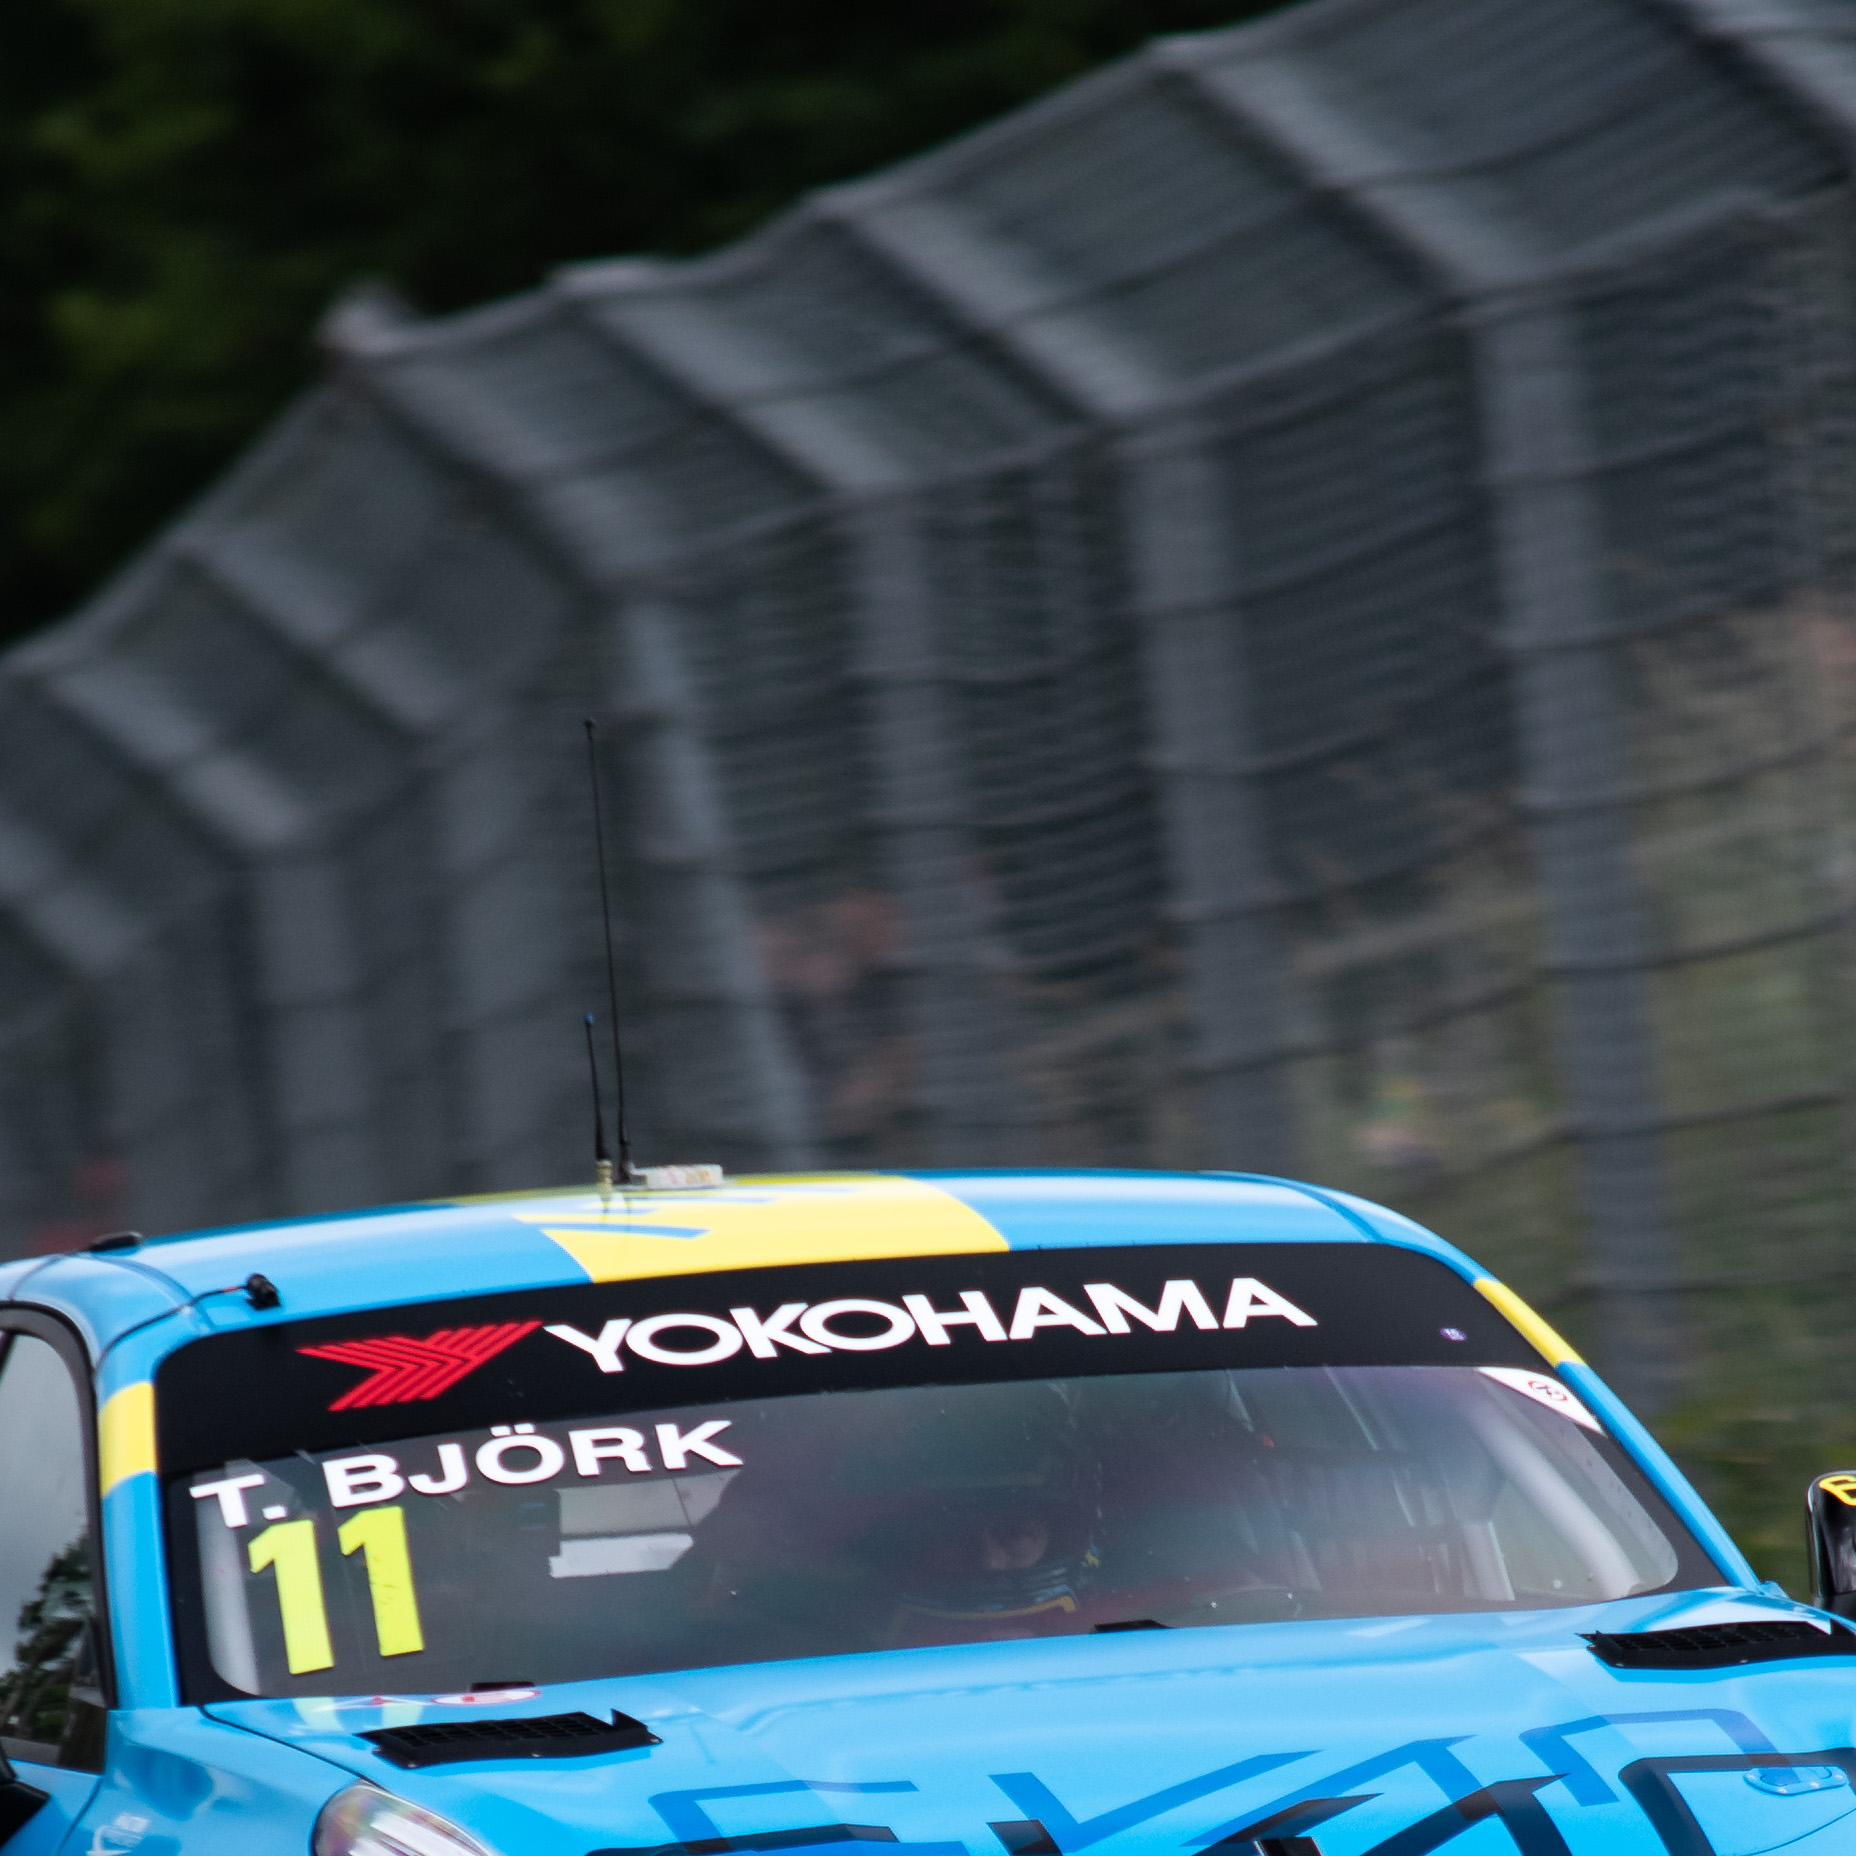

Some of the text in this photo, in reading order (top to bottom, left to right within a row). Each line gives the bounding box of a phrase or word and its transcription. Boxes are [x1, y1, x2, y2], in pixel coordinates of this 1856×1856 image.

[543, 1277, 1319, 1374] YOKOHAMA
[188, 1419, 745, 1529] T. BJÖRK
[246, 1505, 426, 1676] 11
